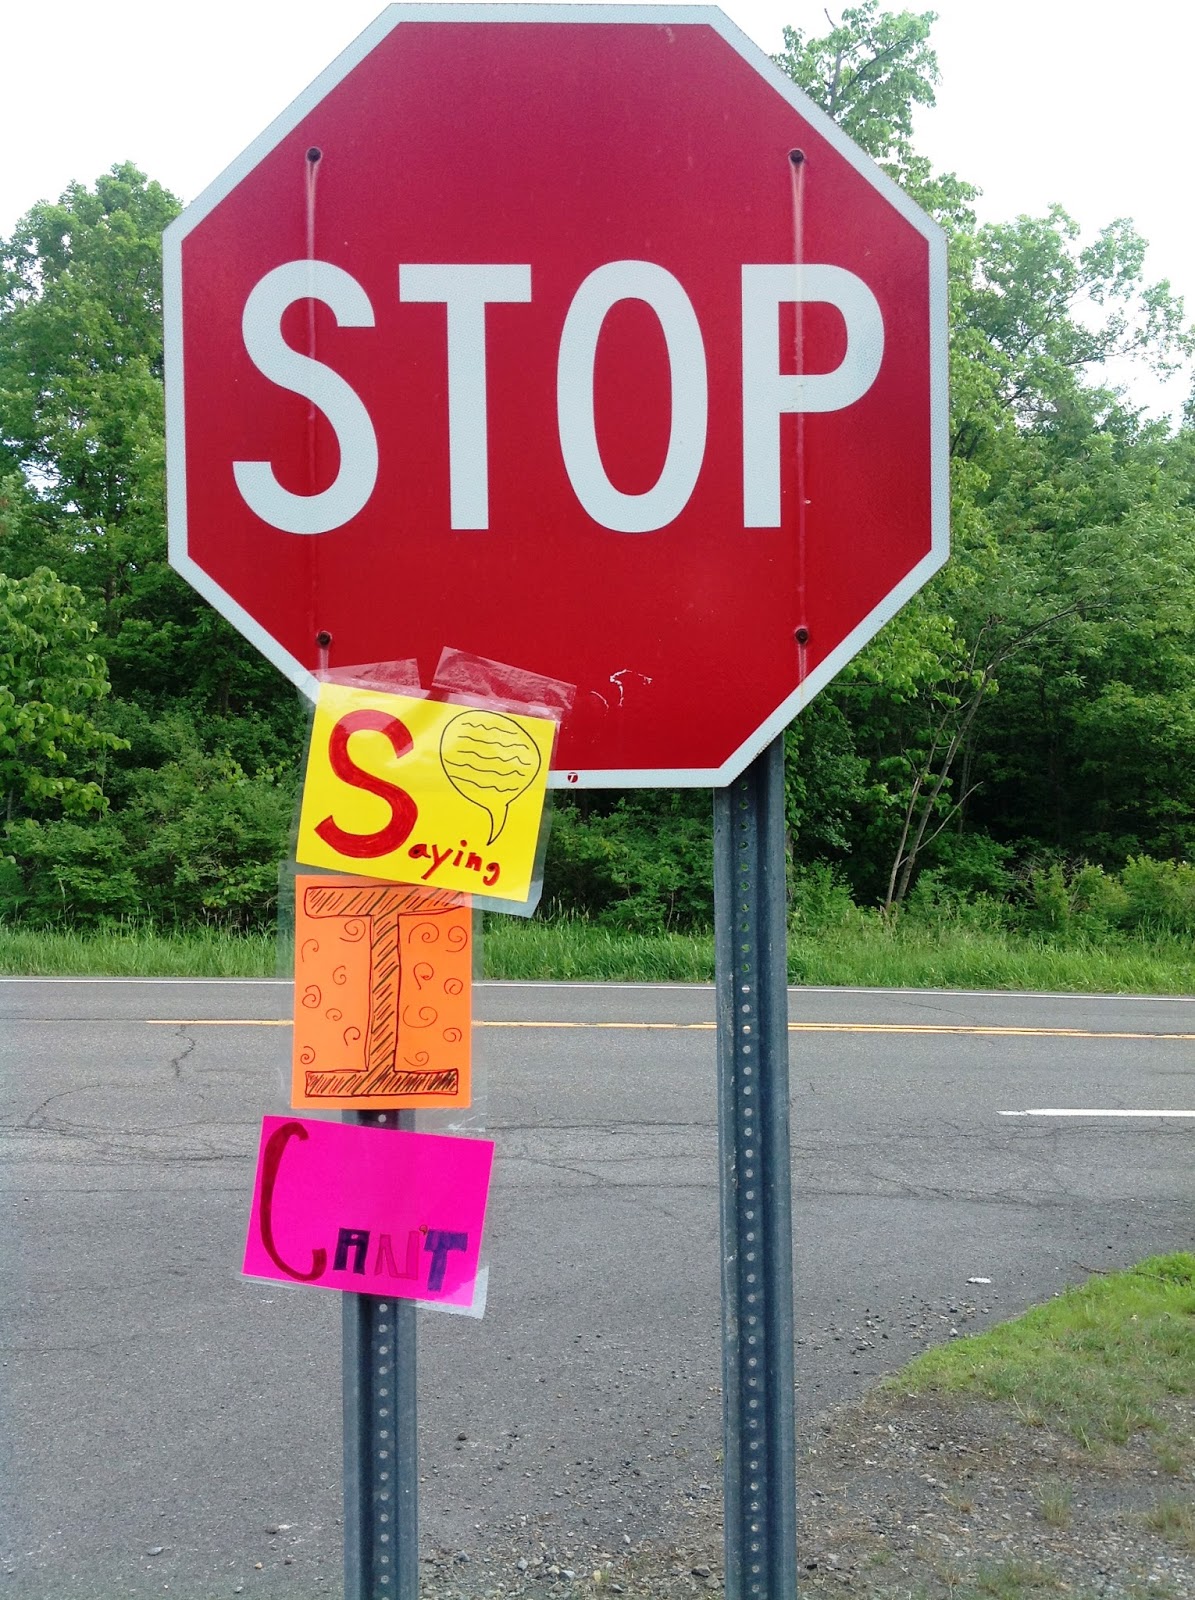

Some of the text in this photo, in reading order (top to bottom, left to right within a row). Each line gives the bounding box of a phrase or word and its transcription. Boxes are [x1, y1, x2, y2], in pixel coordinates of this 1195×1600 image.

[232, 259, 885, 535] STOP
[314, 709, 501, 886] Saying
[304, 884, 465, 1097] I
